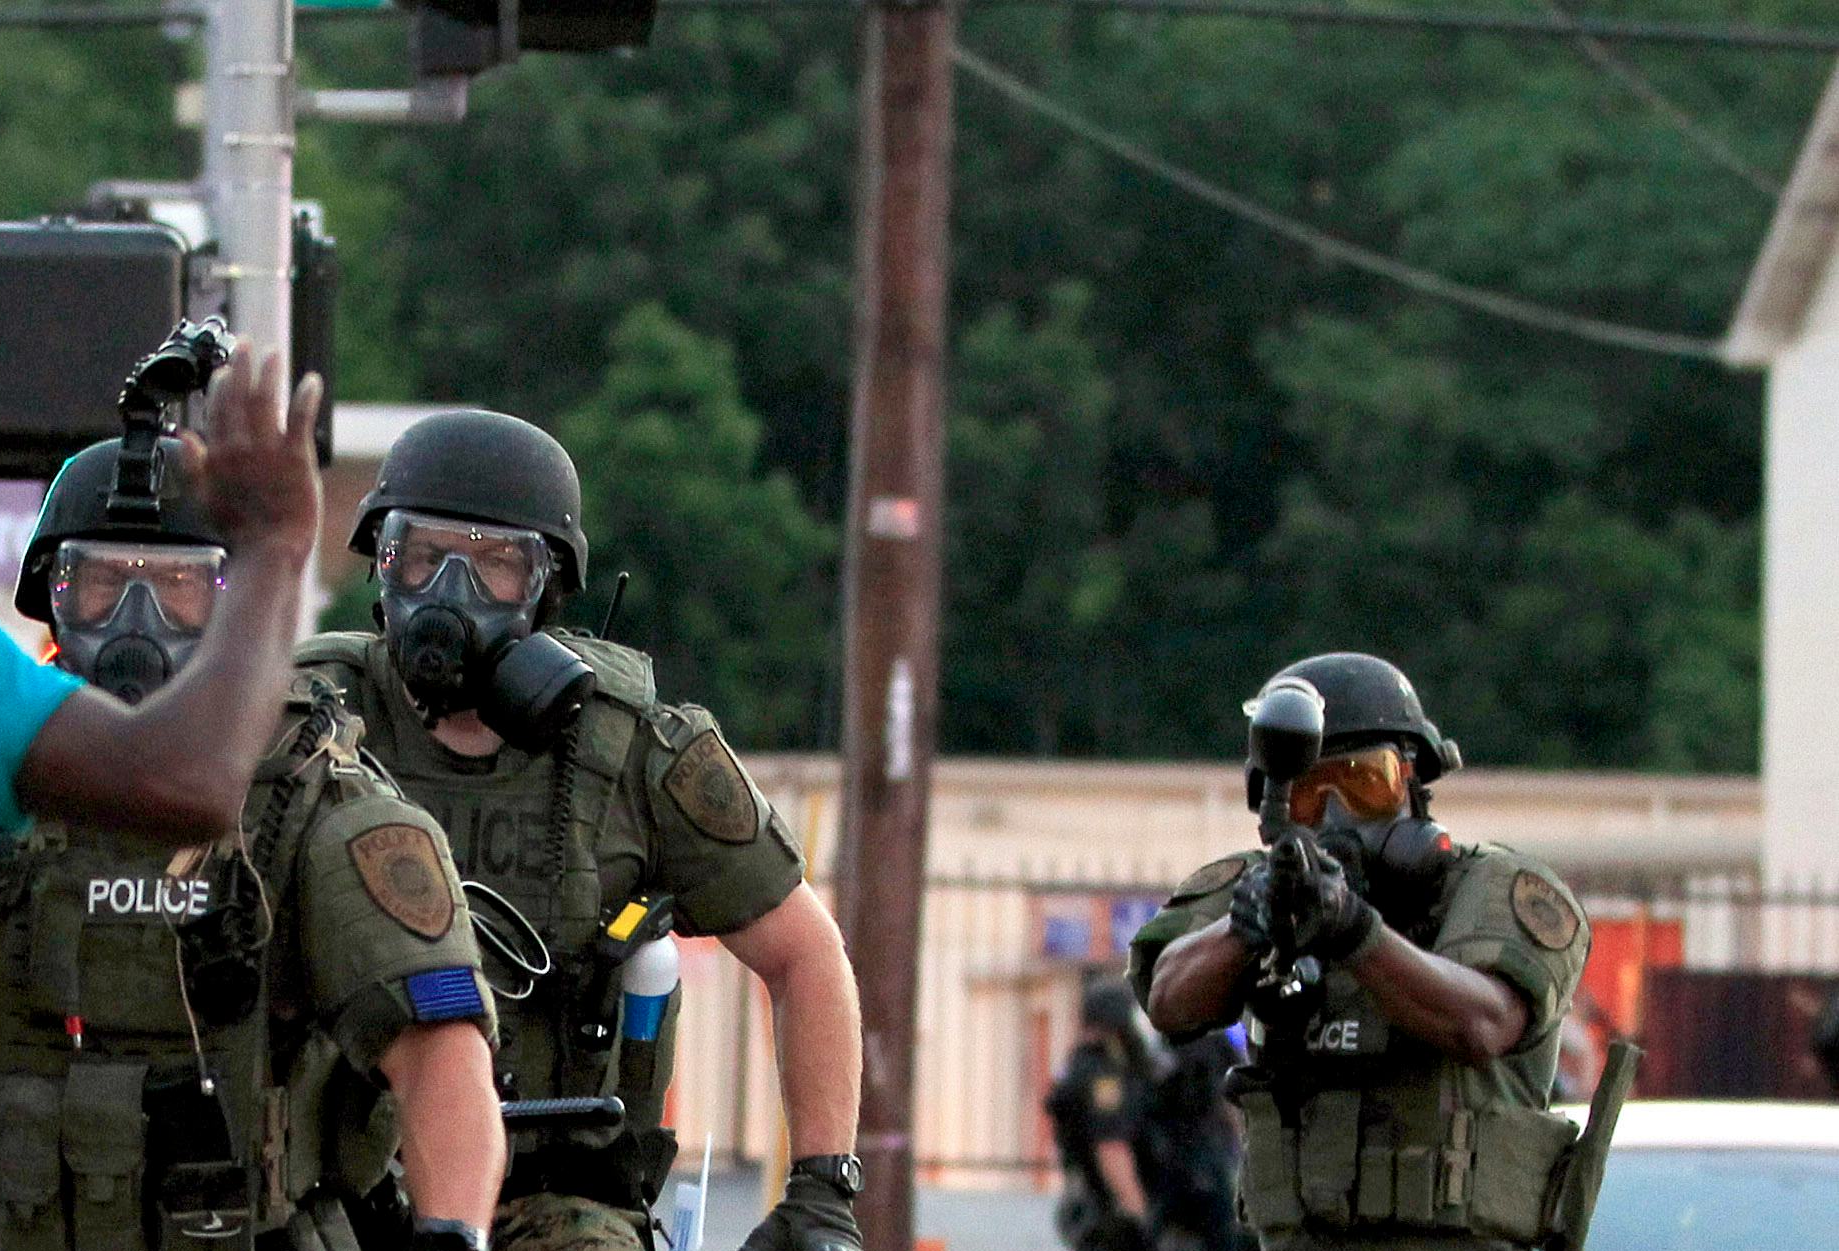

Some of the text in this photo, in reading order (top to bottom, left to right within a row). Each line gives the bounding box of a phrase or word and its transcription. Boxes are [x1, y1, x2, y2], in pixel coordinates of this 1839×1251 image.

[443, 807, 557, 876] LICE
[87, 878, 210, 915] POLICE
[1305, 1018, 1360, 1051] LICE
